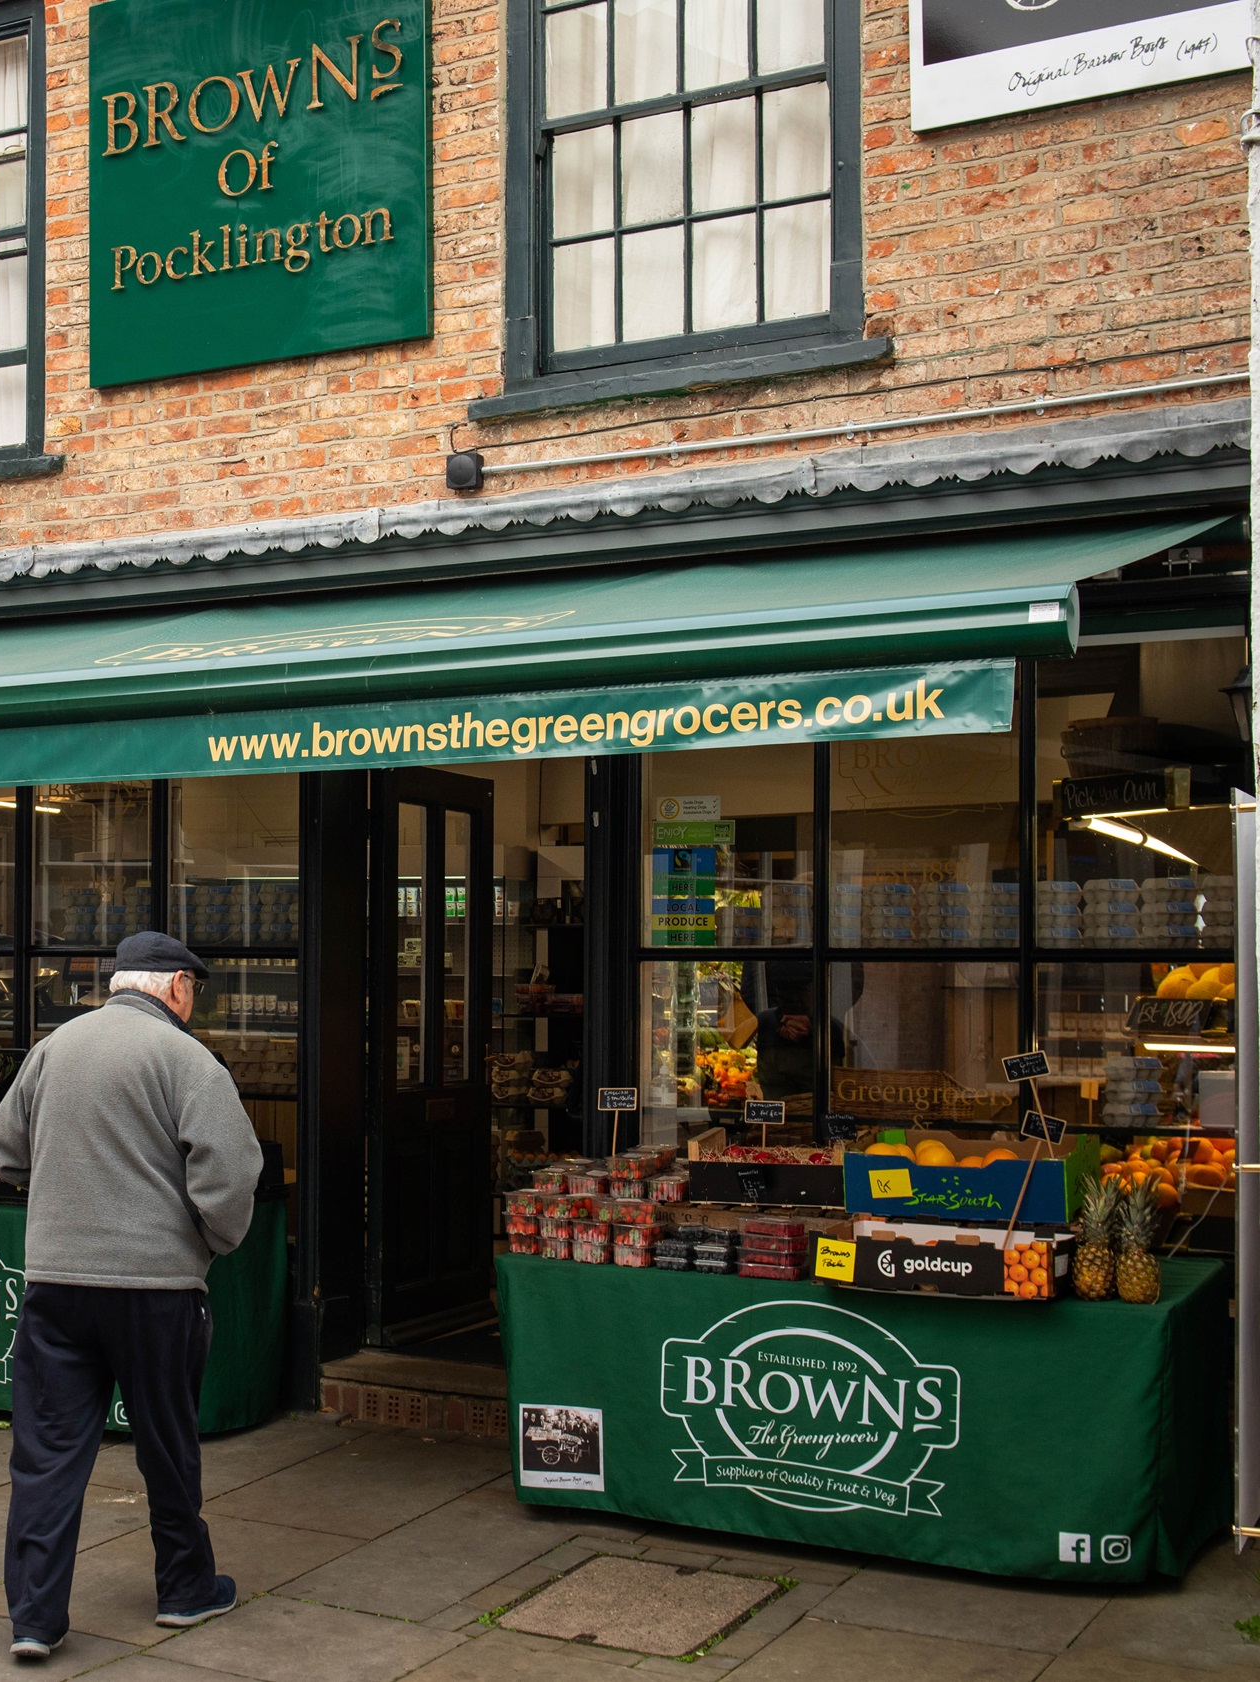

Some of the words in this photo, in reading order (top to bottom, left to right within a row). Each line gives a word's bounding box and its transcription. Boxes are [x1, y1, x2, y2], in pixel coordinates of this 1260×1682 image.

[1008, 58, 1071, 96] Original
[1073, 49, 1128, 76] Barrow
[1130, 35, 1170, 66] Boys
[102, 18, 403, 157] BROWNS
[218, 141, 279, 197] Of
[110, 207, 395, 290] Pocklington
[208, 679, 946, 763] www.brownsthegreengrocers.co.uk
[1065, 783, 1099, 809] Pick
[656, 826, 687, 840] ENJOY
[672, 883, 694, 891] HERE
[658, 917, 708, 926] PRODUCE
[666, 903, 700, 912] LOCAL
[670, 933, 696, 942] HERE
[837, 1079, 1013, 1110] Greengrocers
[903, 1188, 944, 1206] STAR
[904, 1257, 972, 1276] goldcup
[757, 1351, 828, 1370] ESTABLISHED.
[831, 1360, 858, 1374] 1892
[682, 1355, 943, 1433] BROWNS
[745, 1420, 778, 1446] The
[777, 1424, 879, 1461] Greengrocers
[716, 1465, 765, 1481] Suppliers
[766, 1469, 779, 1482] of
[779, 1471, 824, 1491] Quality
[826, 1479, 859, 1495] Fruit
[860, 1484, 870, 1496] &
[873, 1488, 897, 1507] Veg
